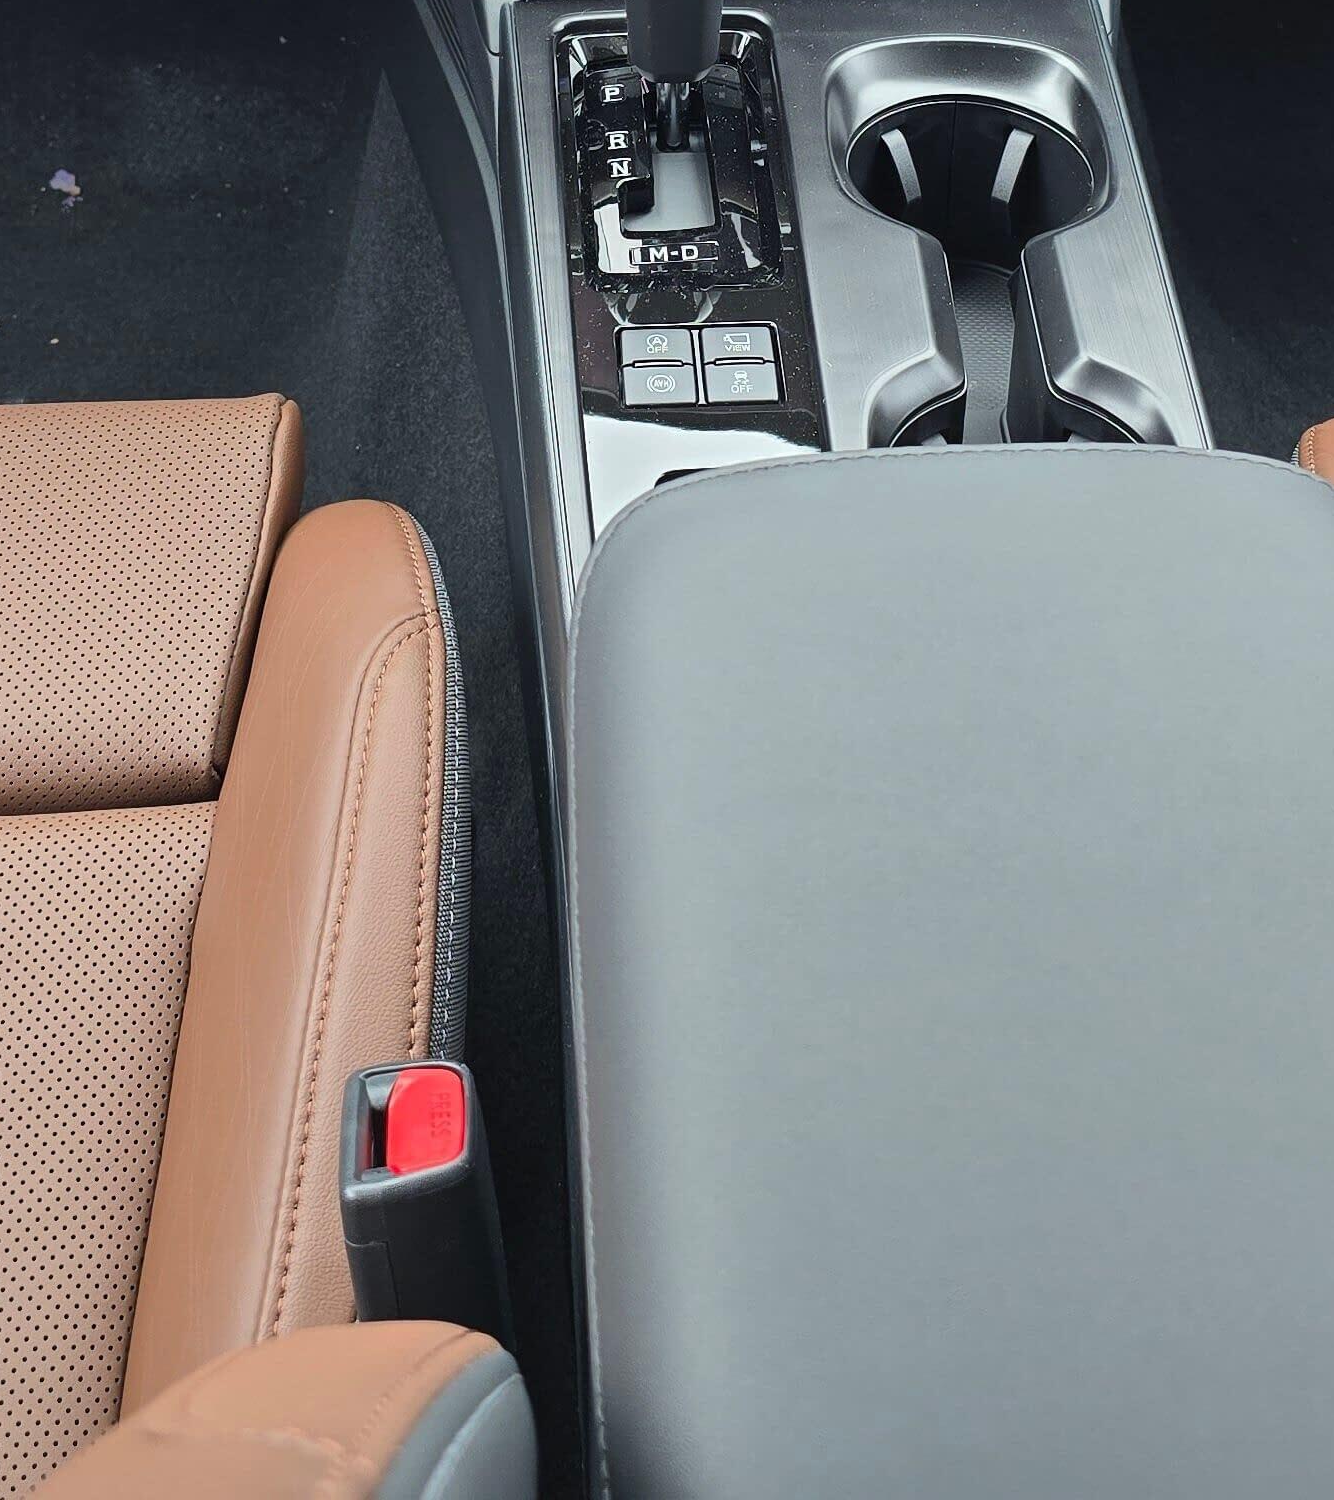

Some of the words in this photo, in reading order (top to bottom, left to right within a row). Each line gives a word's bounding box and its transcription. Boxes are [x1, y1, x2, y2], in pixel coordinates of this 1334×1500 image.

[603, 87, 622, 101] P
[608, 132, 628, 148] R
[611, 161, 630, 176] N
[731, 385, 753, 393] OFF
